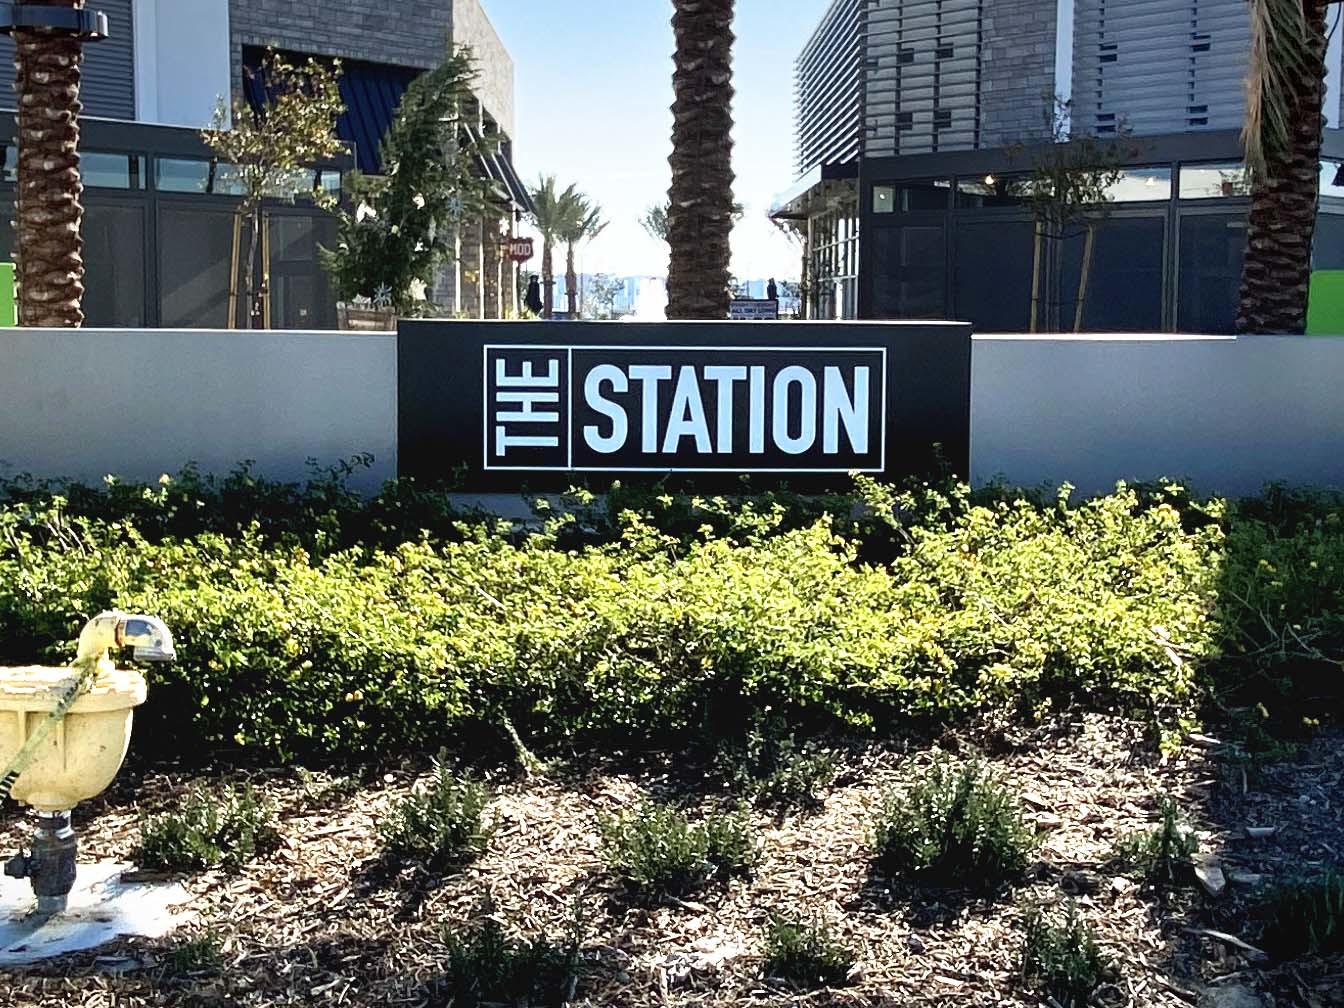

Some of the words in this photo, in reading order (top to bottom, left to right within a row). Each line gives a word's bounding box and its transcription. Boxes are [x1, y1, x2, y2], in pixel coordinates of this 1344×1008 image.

[509, 242, 531, 256] MOD
[496, 357, 560, 457] THE
[582, 363, 871, 455] STATION
